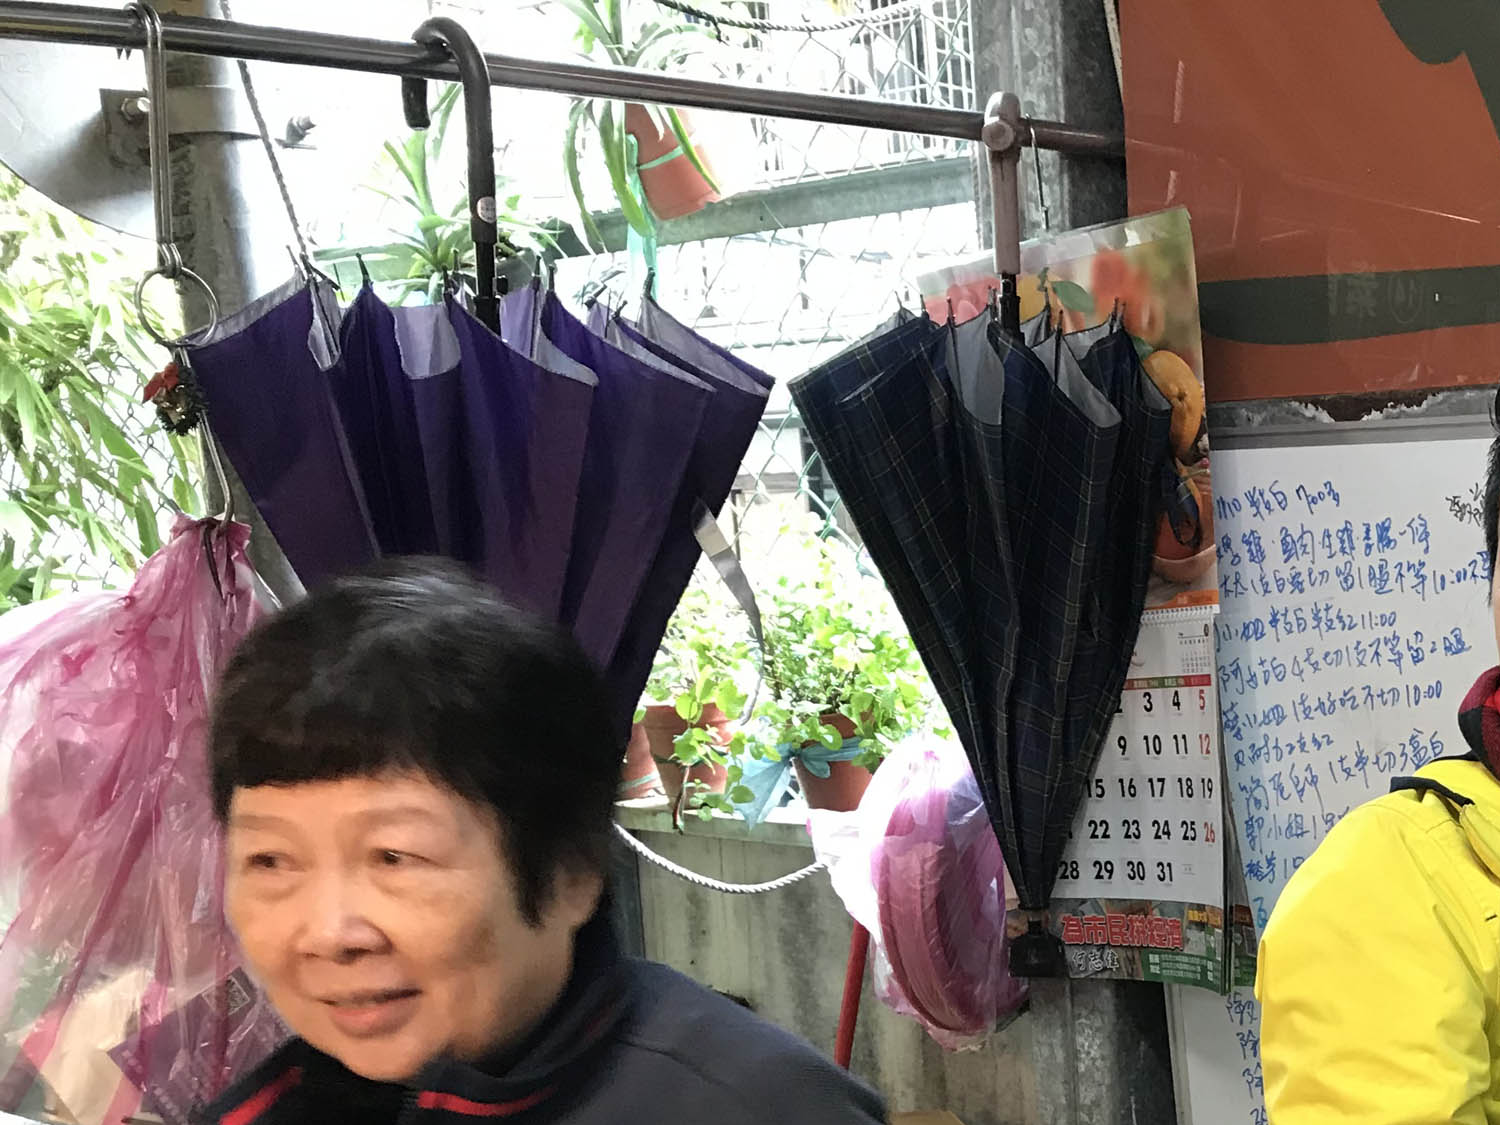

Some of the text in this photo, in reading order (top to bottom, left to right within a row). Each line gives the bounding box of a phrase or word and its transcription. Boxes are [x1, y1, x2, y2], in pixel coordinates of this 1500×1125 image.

[1143, 689, 1206, 712] 3 4 5
[1118, 736, 1127, 756] 9
[1143, 734, 1162, 755] 10
[1173, 734, 1188, 754] 11
[1199, 733, 1211, 755] 12
[1086, 777, 1213, 799] 15 16 17 18 19
[1088, 819, 1216, 843] 22 23 24 25 26
[1058, 860, 1174, 882] 28 29 30 31
[1072, 949, 1120, 972] 何志偉
